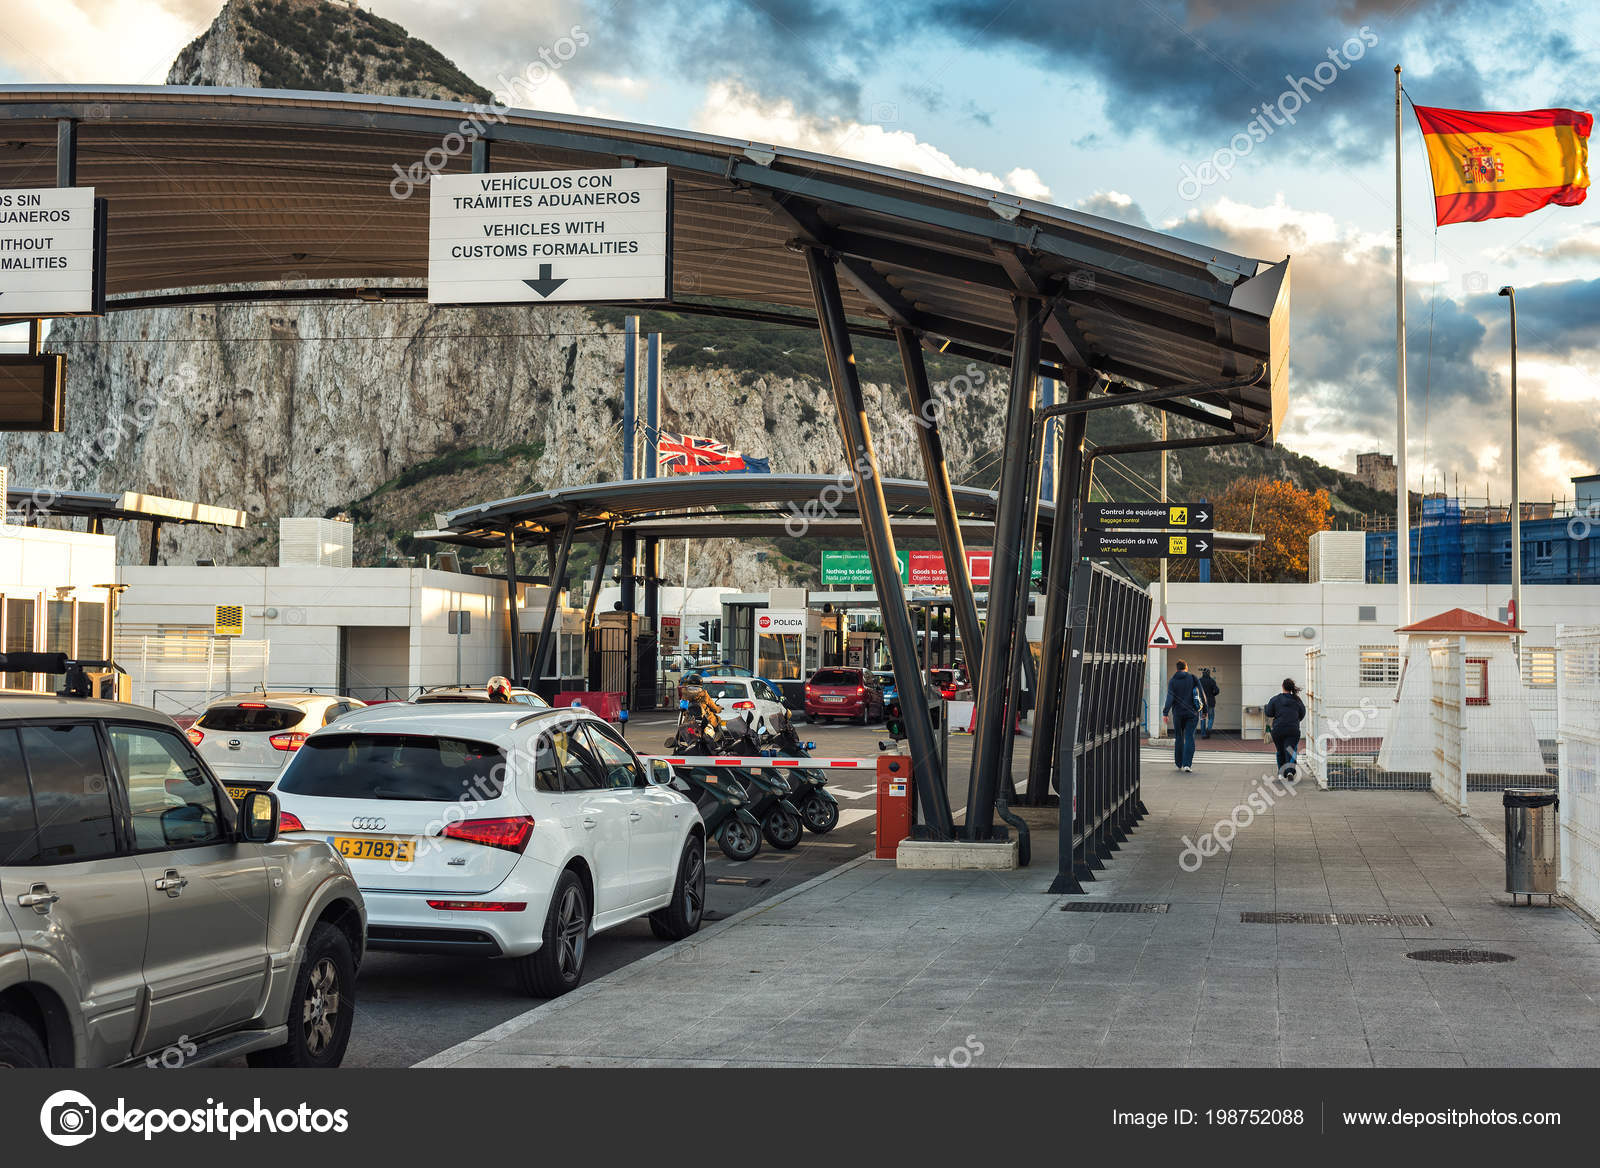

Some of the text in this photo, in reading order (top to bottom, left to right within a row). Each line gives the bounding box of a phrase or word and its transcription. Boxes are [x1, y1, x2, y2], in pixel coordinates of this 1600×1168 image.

[481, 175, 612, 191] VEHÍCULOS CON
[17, 194, 41, 206] SIN
[453, 192, 640, 209] TRÁMITES ADUANEROS
[483, 221, 605, 236] VEHICLES WITH
[1, 237, 54, 250] ITHOUT
[452, 241, 638, 258] CUSTOMS FORMALITIES
[1, 256, 67, 269] MALITIES
